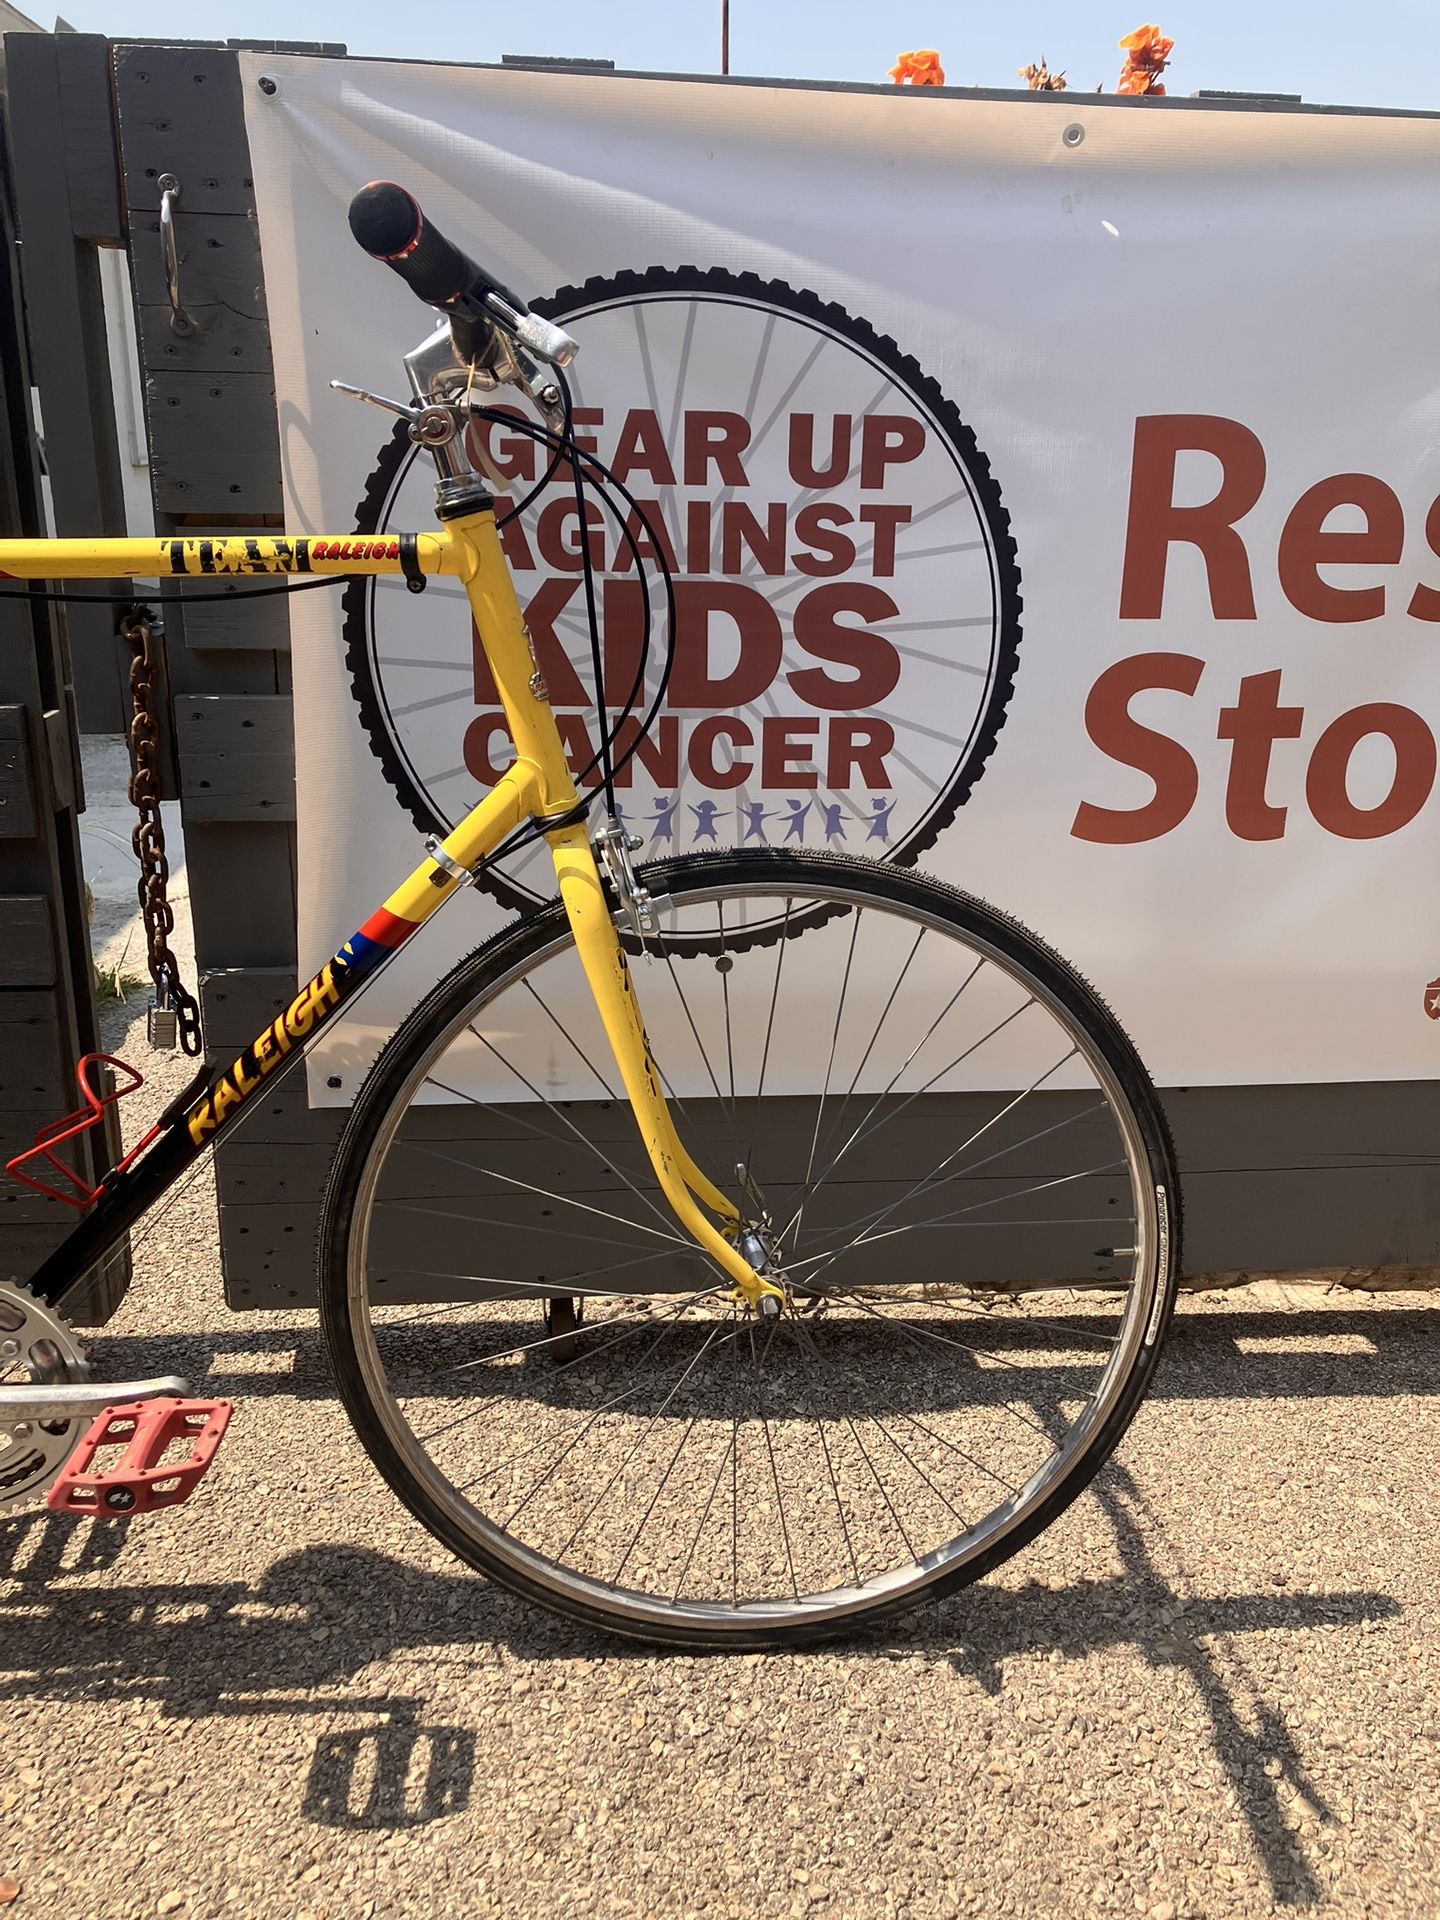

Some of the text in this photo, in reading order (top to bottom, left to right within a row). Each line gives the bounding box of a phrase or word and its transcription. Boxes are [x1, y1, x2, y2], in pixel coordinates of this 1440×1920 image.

[465, 404, 927, 490] GEAR UP
[312, 542, 400, 560] RALEIGH
[494, 496, 912, 578] AGAINST
[472, 578, 902, 711] KIDS
[462, 712, 895, 790] CANCER
[1070, 652, 1438, 845] Sto
[187, 962, 341, 1146] RALEIGH
[1157, 1191, 1167, 1234] Panaracer
